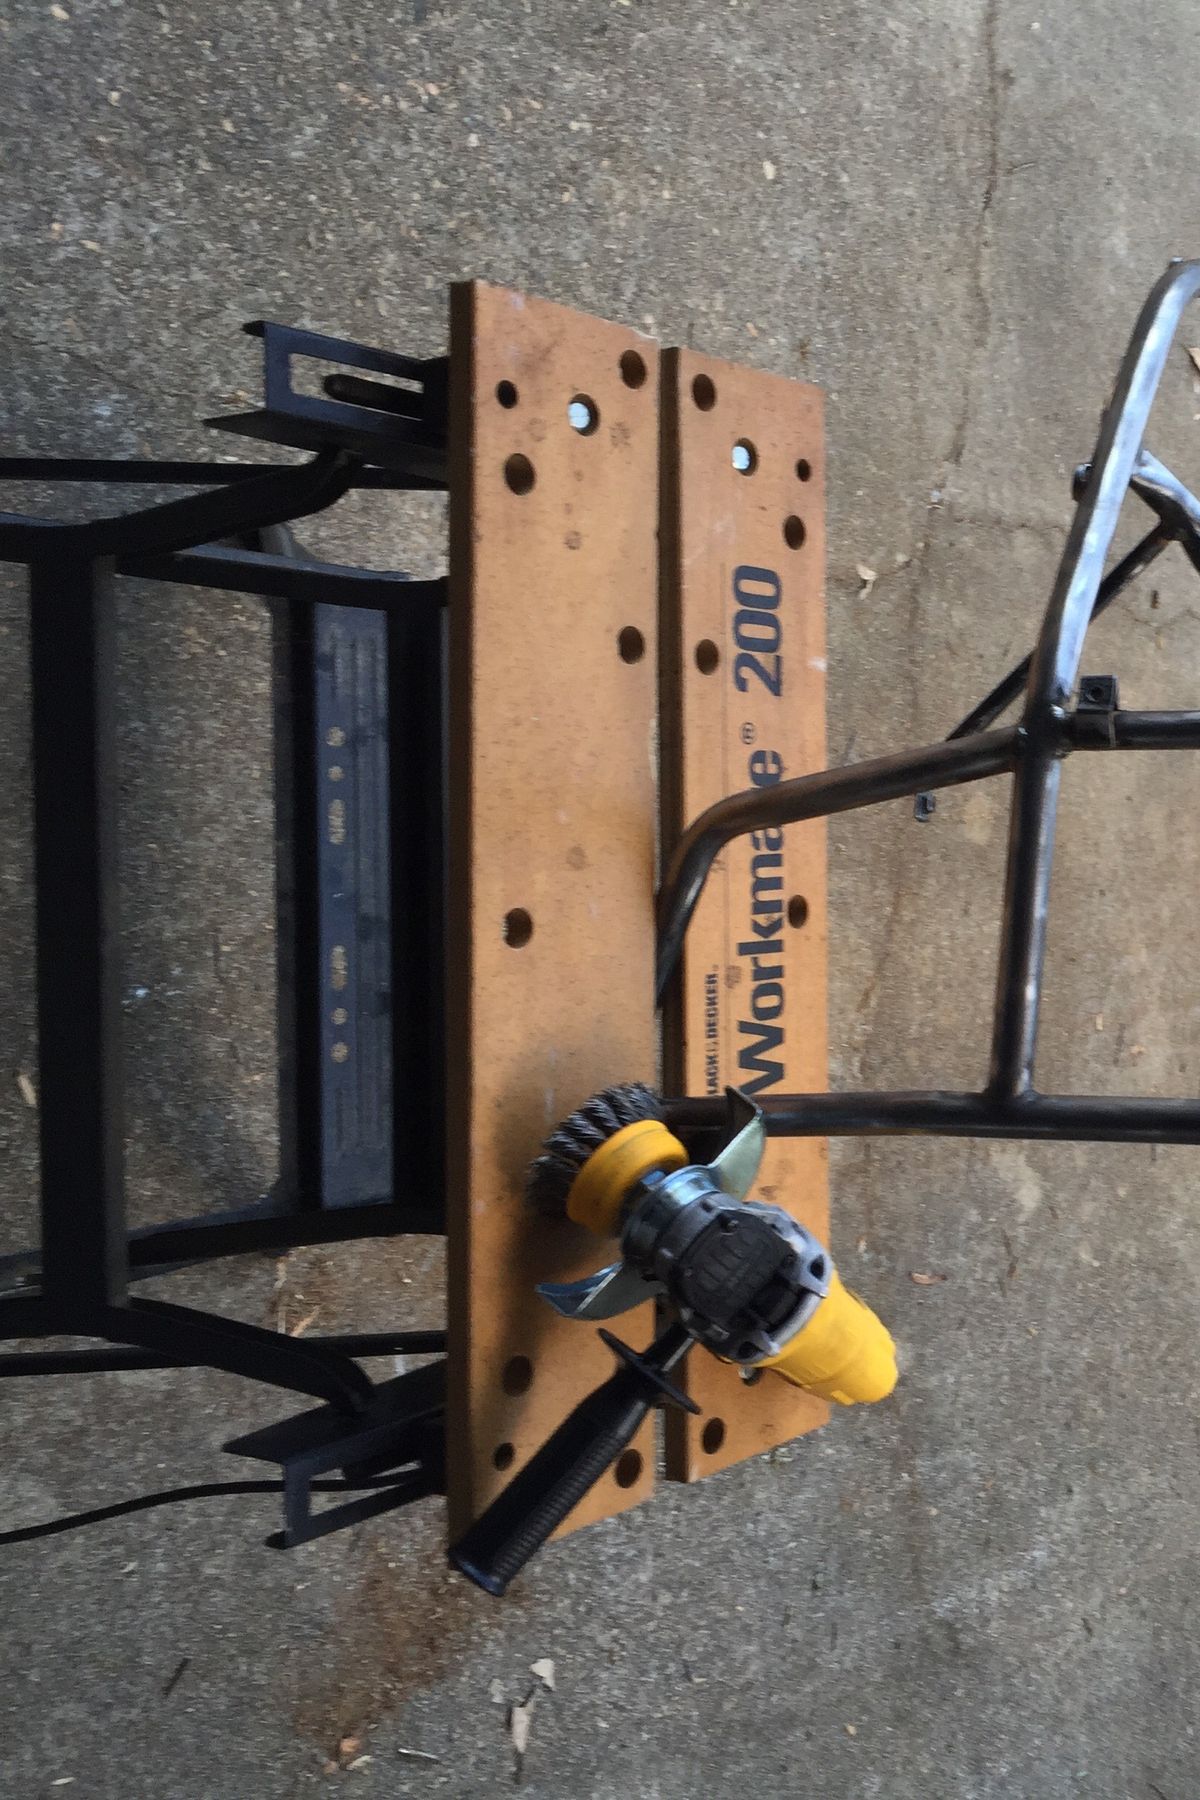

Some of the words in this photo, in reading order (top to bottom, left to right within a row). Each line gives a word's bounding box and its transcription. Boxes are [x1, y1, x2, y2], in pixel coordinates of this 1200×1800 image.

[733, 565, 783, 697] 200
[738, 750, 784, 1095] Workmae
[705, 973, 718, 1096] LACK&DECKER
